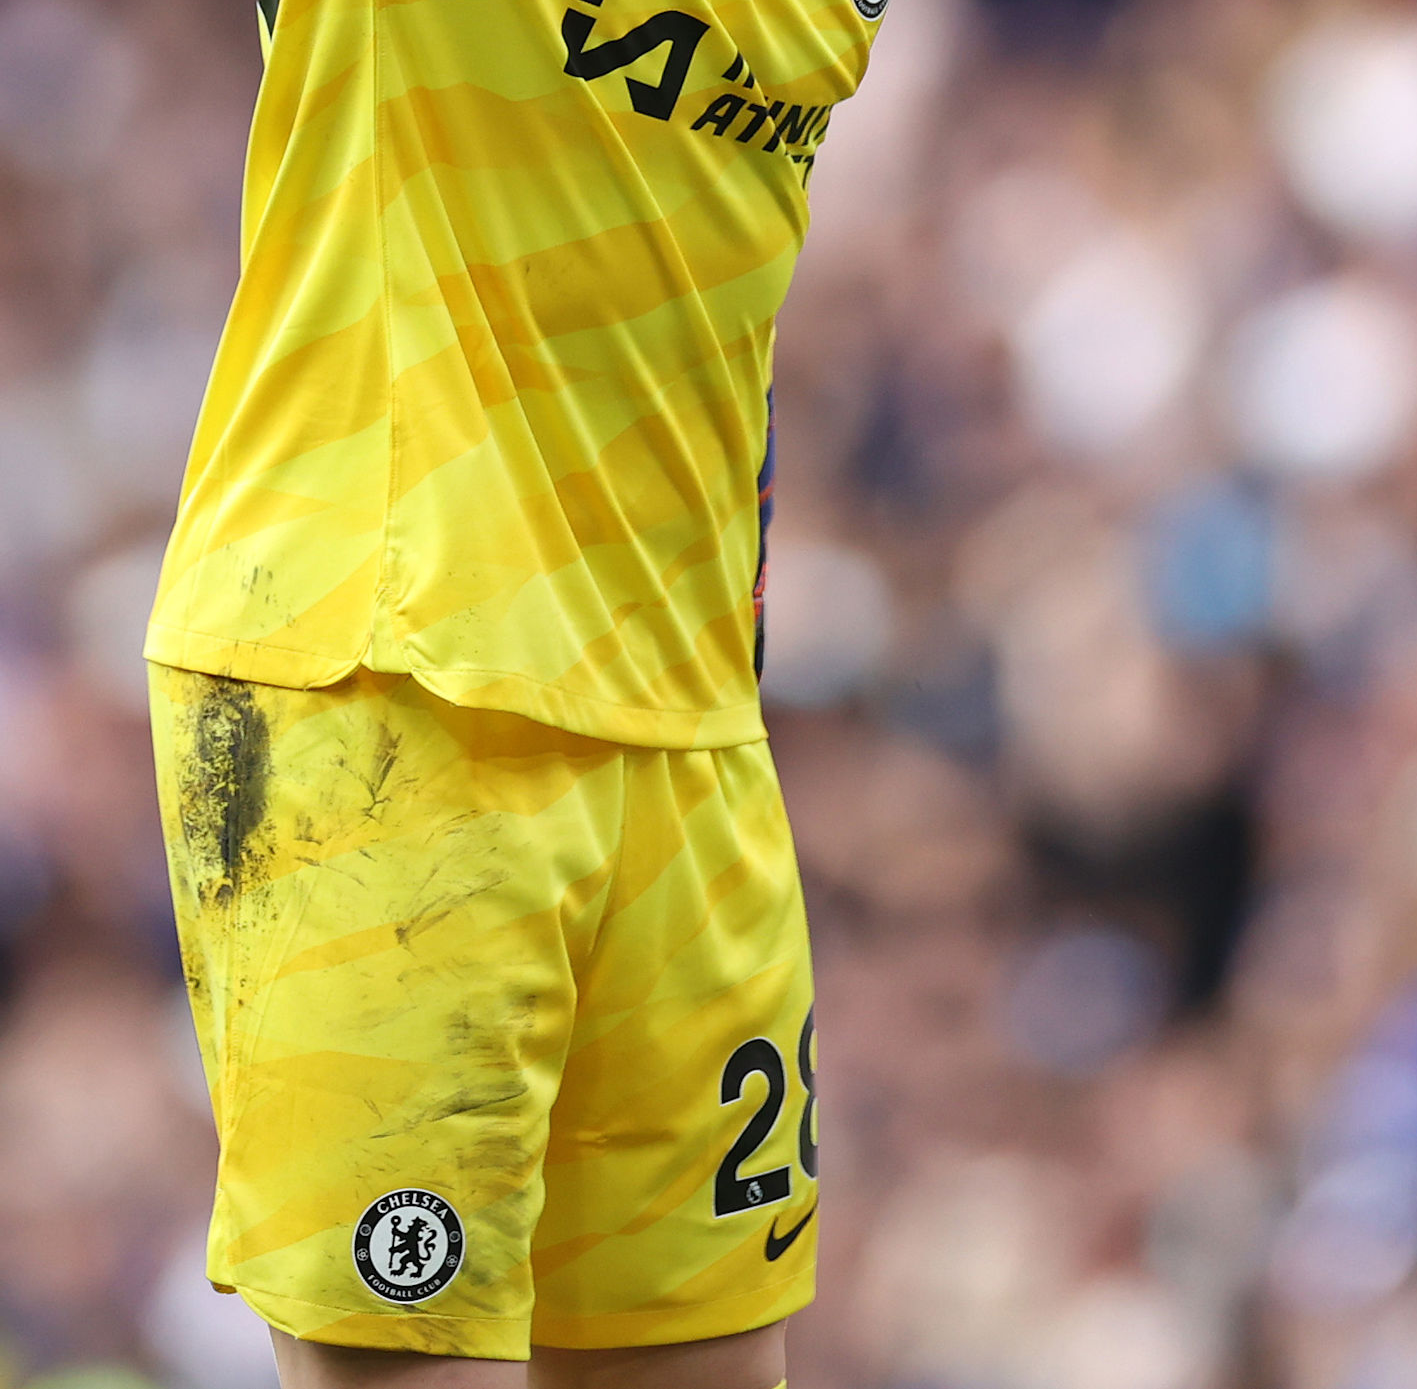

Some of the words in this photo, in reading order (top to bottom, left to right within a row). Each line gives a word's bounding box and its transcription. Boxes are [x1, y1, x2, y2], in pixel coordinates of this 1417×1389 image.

[376, 1192, 450, 1220] CHELSEA
[367, 1273, 414, 1298] FOOTBALL
[416, 1278, 442, 1296] CLUB
